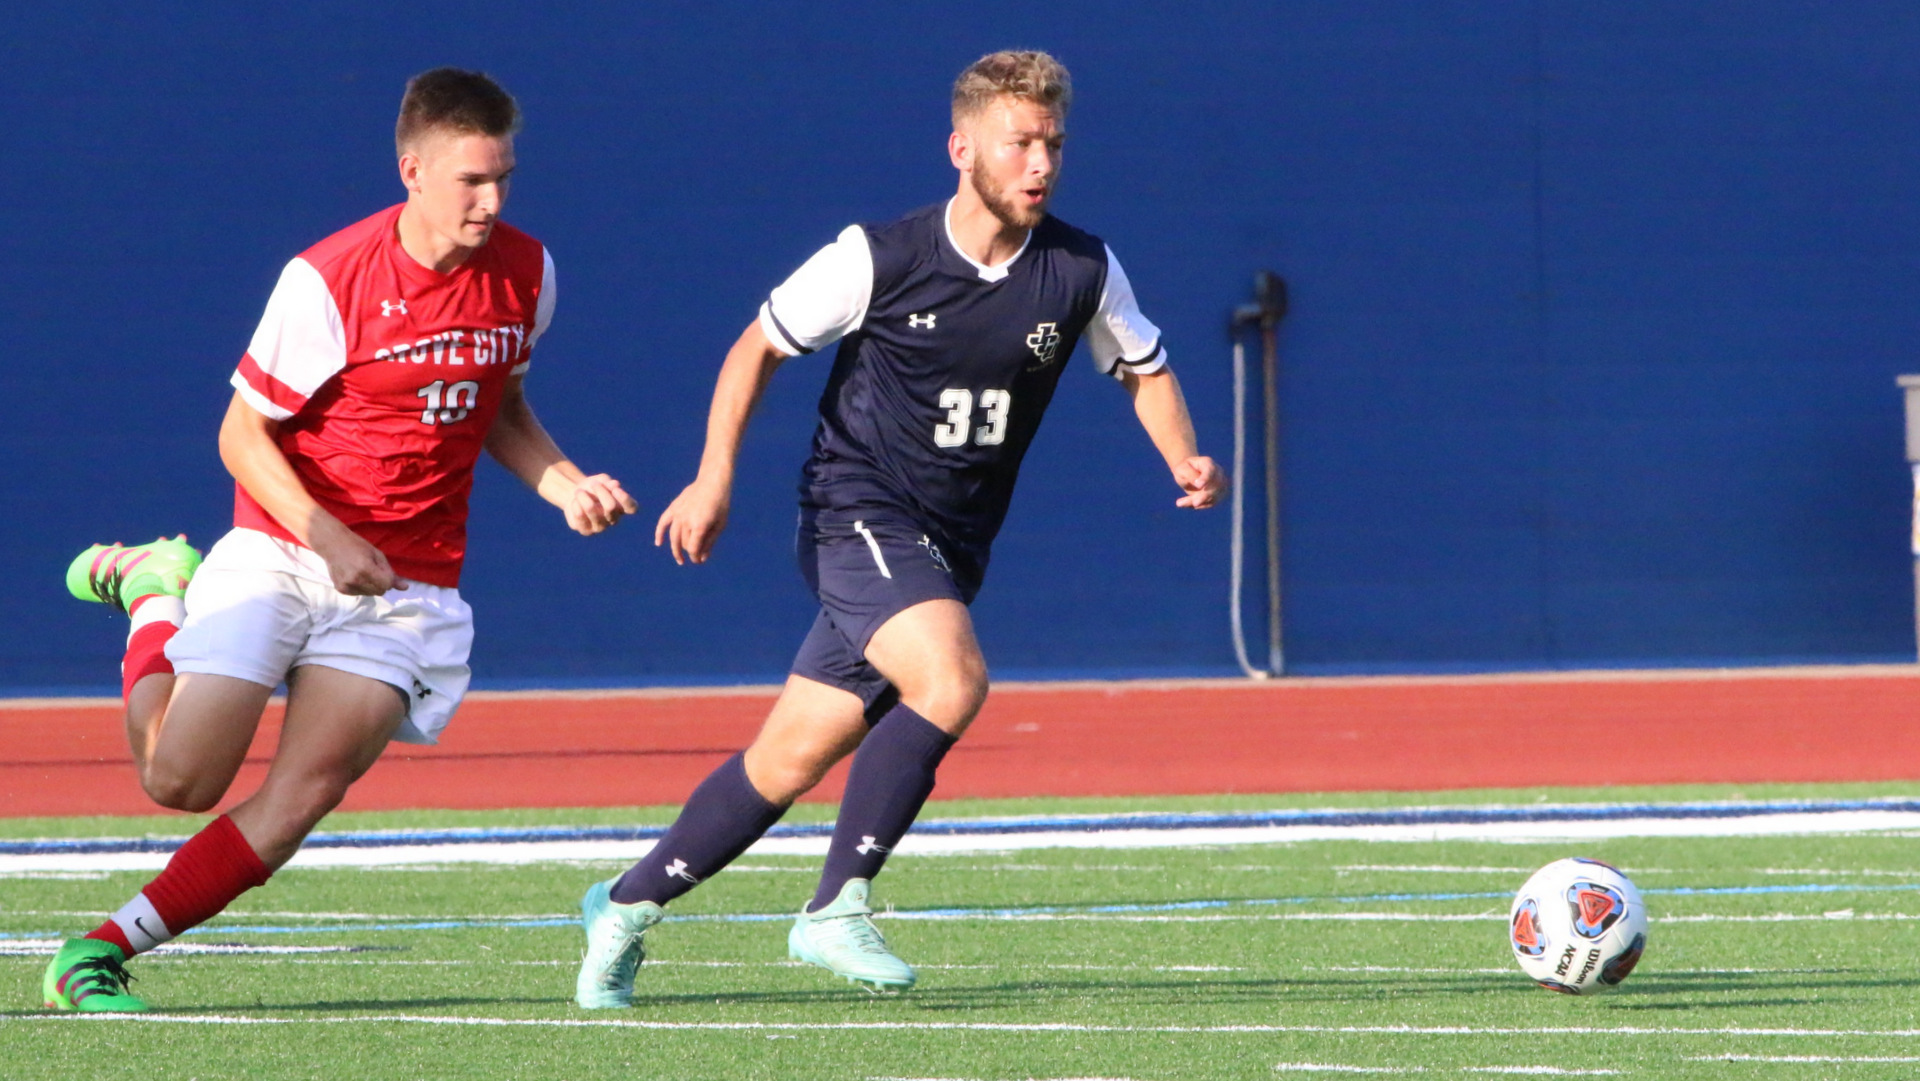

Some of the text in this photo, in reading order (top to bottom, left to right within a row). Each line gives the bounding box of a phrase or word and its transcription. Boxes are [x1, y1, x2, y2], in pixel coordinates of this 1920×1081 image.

[473, 323, 525, 365] CITY
[417, 379, 479, 425] 10
[933, 388, 1011, 448] 33
[1555, 943, 1577, 977] NCAA
[1574, 948, 1601, 984] Wilson
